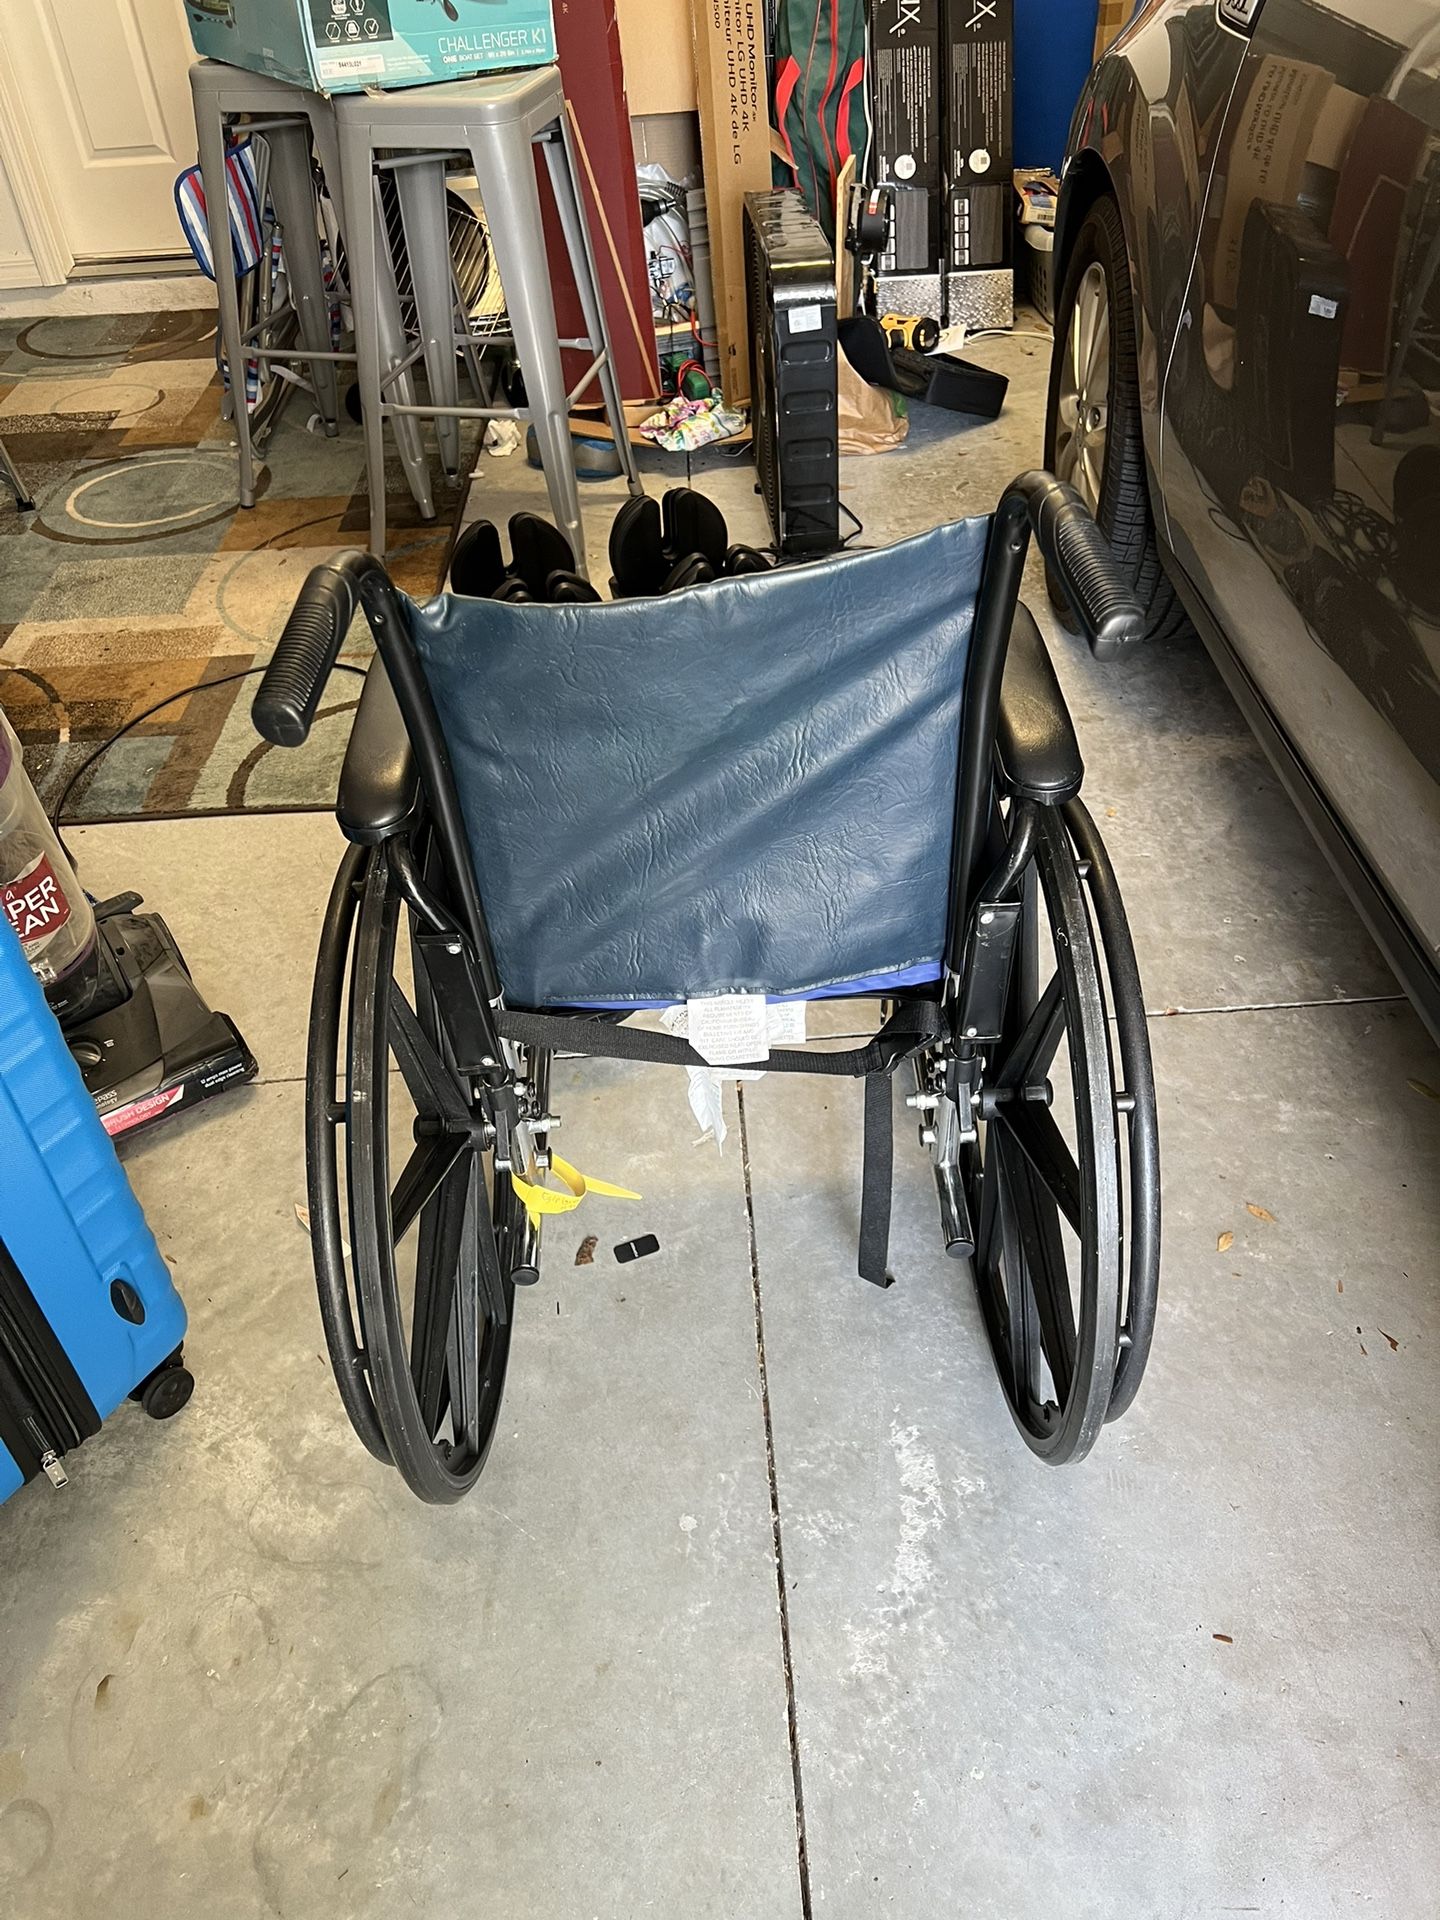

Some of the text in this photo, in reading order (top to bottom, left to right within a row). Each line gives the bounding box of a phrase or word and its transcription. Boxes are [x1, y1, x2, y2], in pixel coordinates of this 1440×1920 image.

[745, 3, 755, 41] UHD
[438, 29, 529, 54] CHALLENGER
[531, 27, 547, 45] K1
[736, 41, 745, 62] LG
[443, 55, 458, 64] ONE
[459, 53, 473, 62] BOAT
[473, 52, 483, 60] SET
[726, 50, 736, 88] UHD
[738, 68, 748, 105] UHD
[747, 43, 758, 111] Monitor
[730, 94, 738, 117] 4K
[731, 120, 738, 139] de
[741, 110, 750, 132] 4K
[733, 144, 741, 165] LG
[135, 1093, 170, 1114] DESIGN
